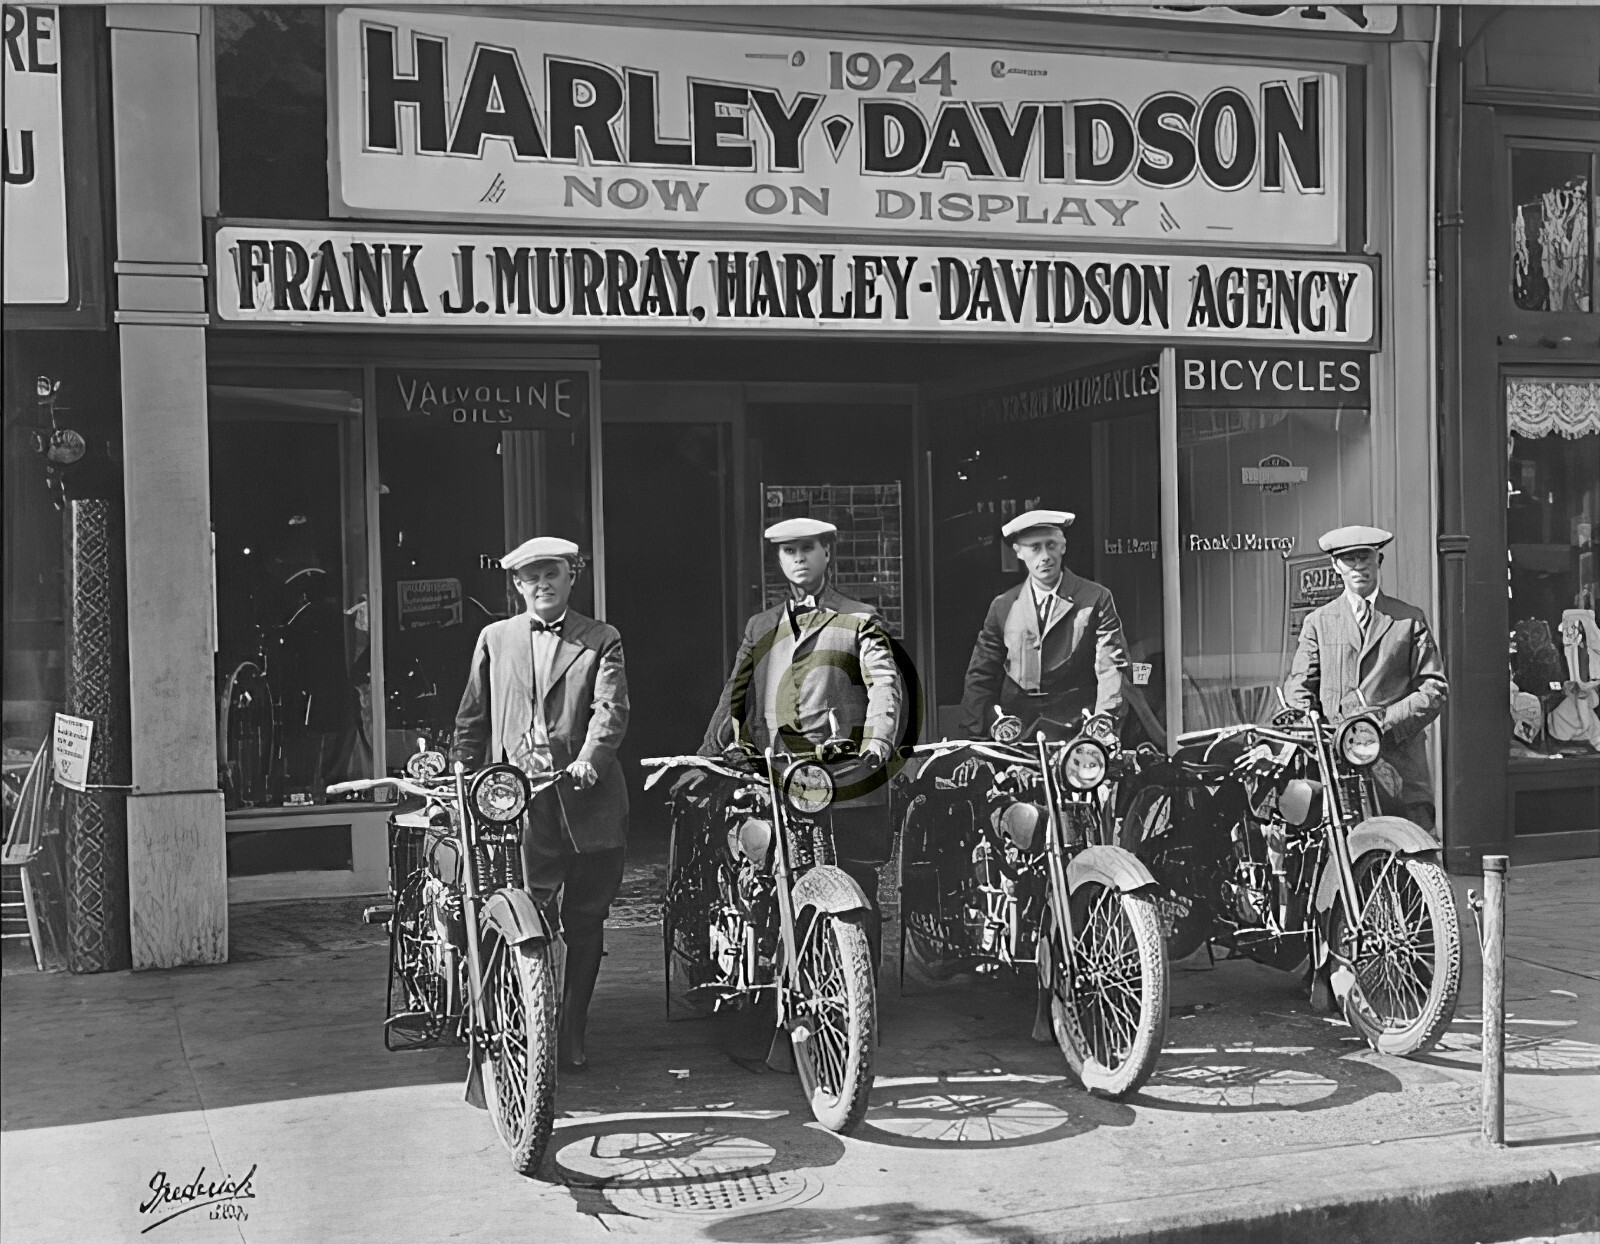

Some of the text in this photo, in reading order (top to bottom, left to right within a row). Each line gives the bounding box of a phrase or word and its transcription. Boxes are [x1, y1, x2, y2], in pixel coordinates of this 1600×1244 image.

[829, 51, 958, 97] 1924
[361, 20, 1325, 194] HARLEY DAVIDSON
[564, 175, 1139, 227] NOW ON DISPLAY
[229, 239, 429, 317] FRANK
[708, 250, 1170, 330] HARLEY-DAVIDSON
[1186, 263, 1360, 334] AGENCY
[397, 375, 572, 418] VALVOLINE
[1184, 359, 1361, 392] BICYCLES
[453, 408, 513, 423] OILS
